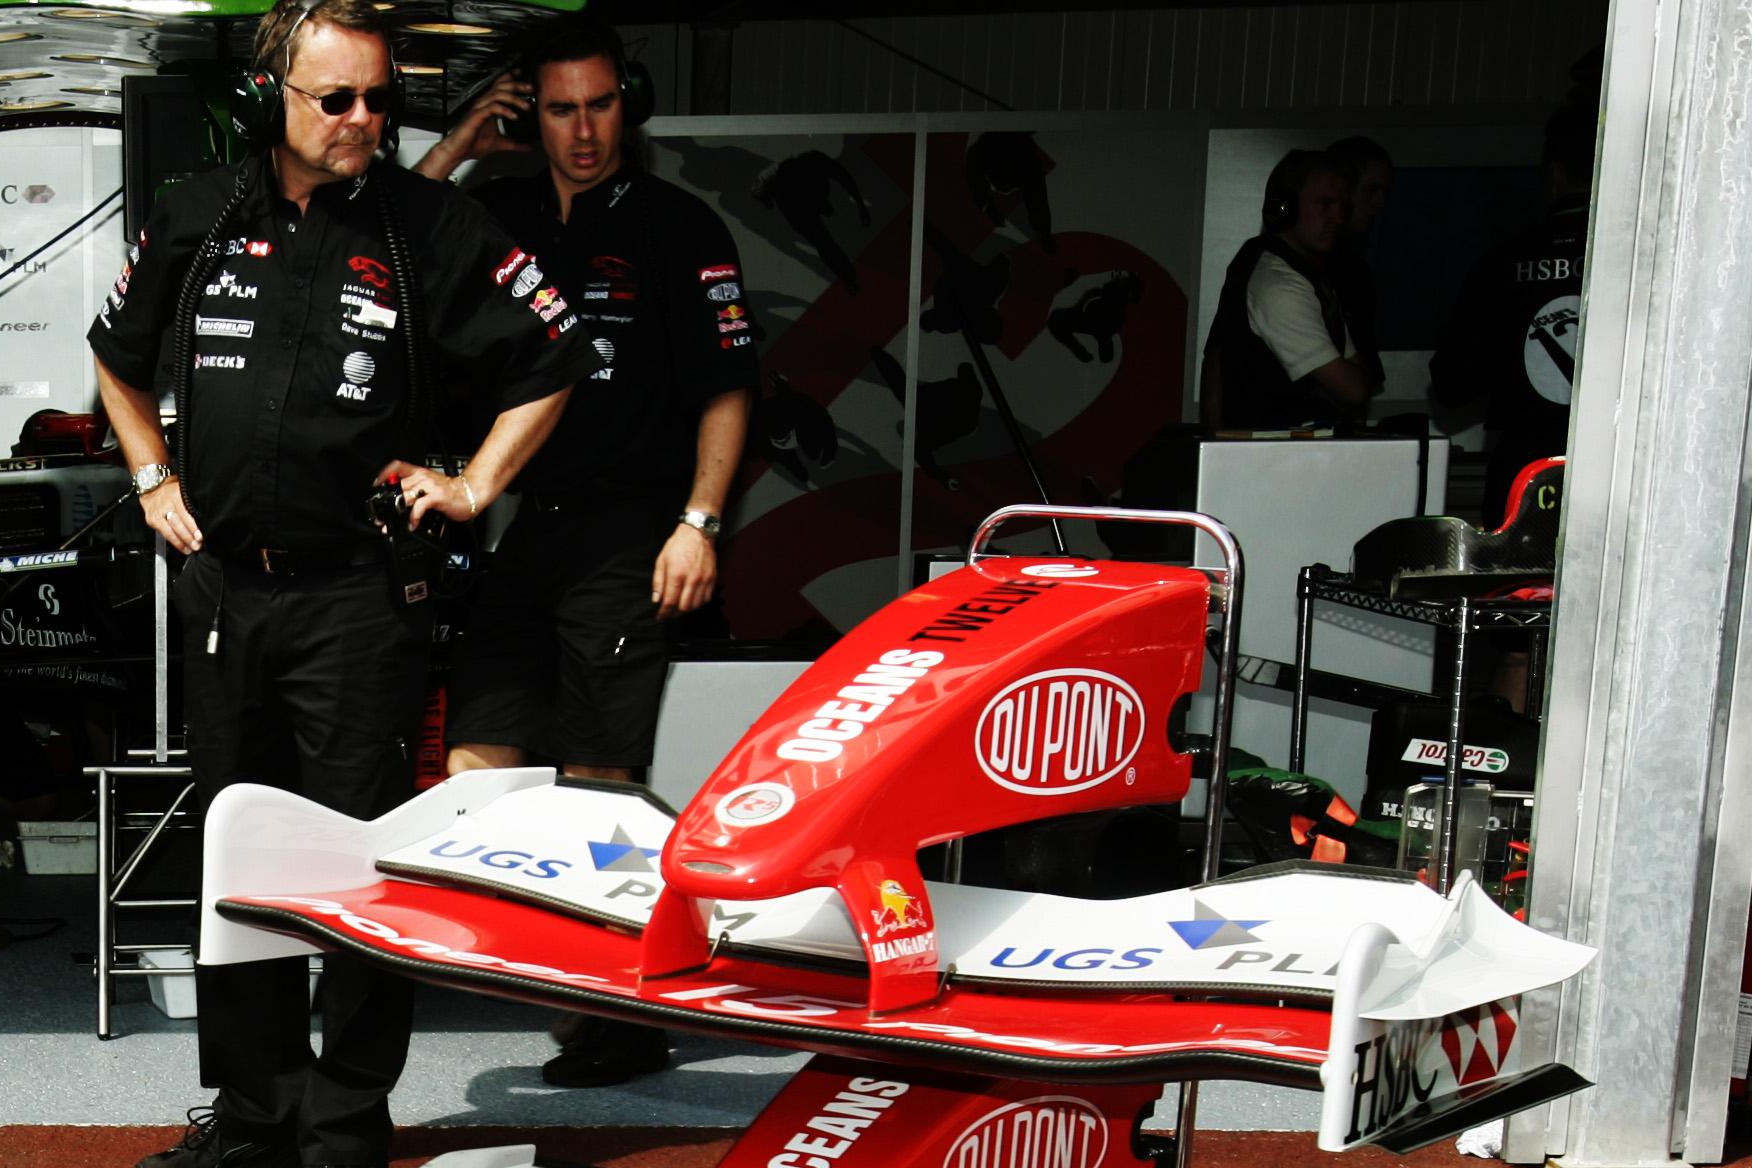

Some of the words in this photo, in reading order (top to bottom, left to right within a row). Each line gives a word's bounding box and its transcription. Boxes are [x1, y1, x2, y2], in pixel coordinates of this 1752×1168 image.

[228, 286, 258, 299] PLM
[343, 284, 376, 297] JAGUAR
[200, 321, 251, 333] MICHELIN
[342, 322, 359, 335] Dave
[336, 382, 372, 401] AT&T
[907, 579, 1060, 644] TWELVE
[776, 648, 945, 763] OCEANS
[429, 840, 573, 879] UGS
[872, 930, 936, 964] HANGAR-7
[989, 946, 1164, 971] UGS
[1215, 949, 1340, 976] PL
[659, 984, 850, 1018] 15
